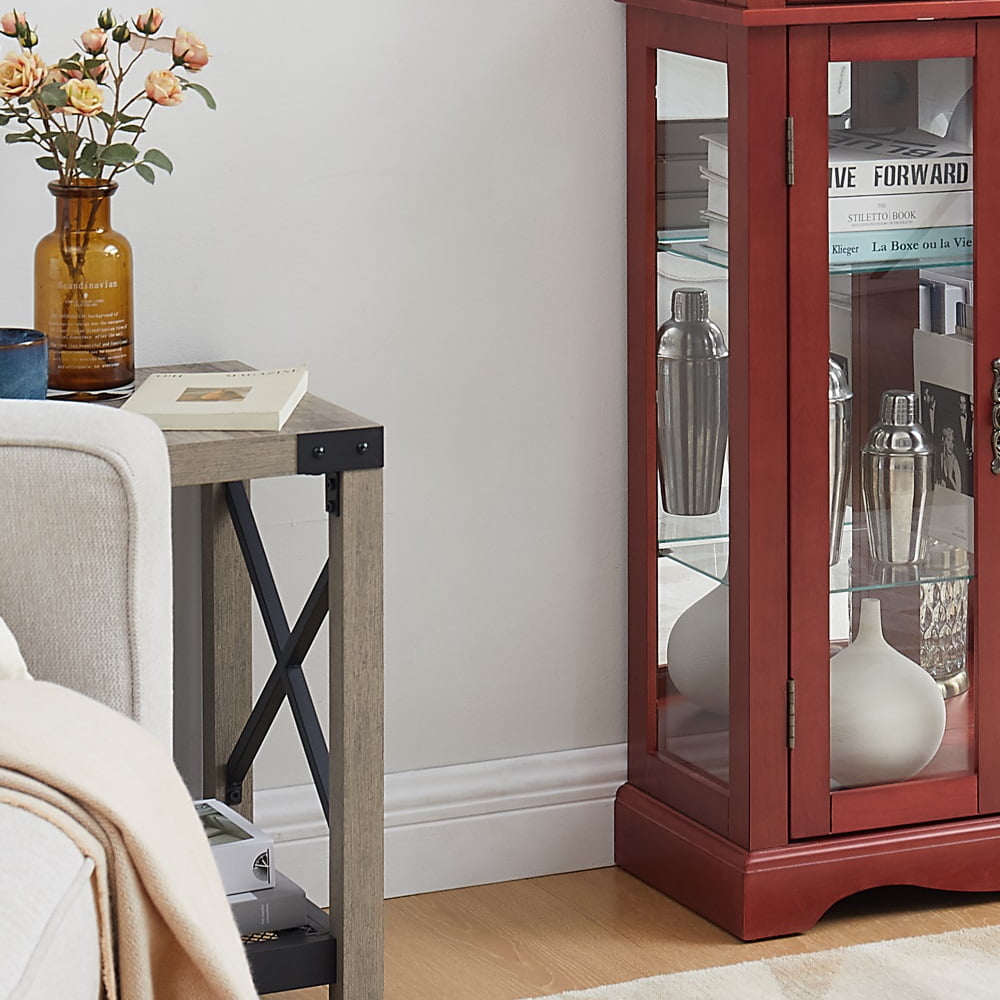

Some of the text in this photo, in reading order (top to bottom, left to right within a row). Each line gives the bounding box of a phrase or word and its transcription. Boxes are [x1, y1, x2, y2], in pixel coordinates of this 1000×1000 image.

[874, 162, 969, 187] FORWARD
[848, 210, 917, 223] STILETTO BOOK
[832, 236, 973, 256] Klieger La Boxe ou la Vie
